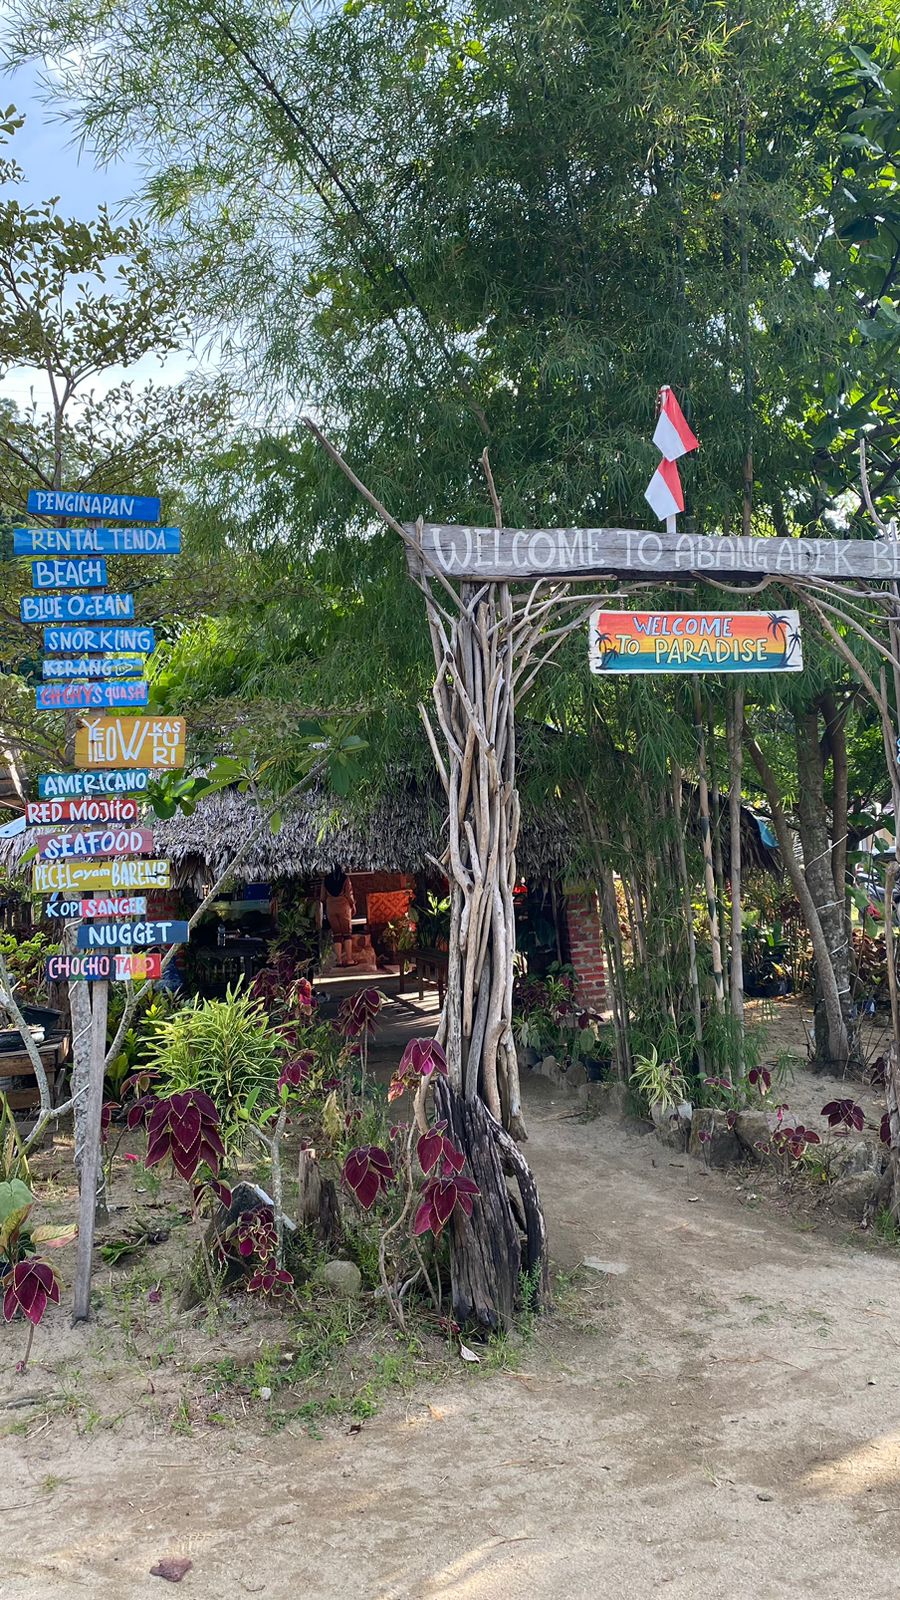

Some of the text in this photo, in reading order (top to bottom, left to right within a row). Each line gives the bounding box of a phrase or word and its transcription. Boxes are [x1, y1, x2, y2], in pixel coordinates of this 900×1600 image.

[36, 491, 134, 516] PENGINAPAN
[28, 528, 167, 552] RENTAL TENDA
[430, 527, 607, 573] WELCOME
[617, 530, 664, 567] TO
[674, 533, 769, 571] ABANG
[775, 538, 855, 575] ADEK
[36, 560, 102, 587] BEACH
[23, 596, 63, 620] BLUE
[632, 615, 733, 638] WELCOME
[615, 634, 768, 664] TO PARADISE
[43, 660, 112, 677] KERANG
[82, 717, 150, 763] YELLOW
[44, 772, 146, 796] AMERICANO
[27, 803, 64, 823] RED
[44, 831, 143, 860] SEAFOOD
[34, 863, 79, 890] PECEL
[72, 868, 111, 881] ayam
[45, 897, 146, 918] KOPI SANGER
[88, 922, 173, 945] NUGGET
[48, 957, 110, 979] CHOCHO
